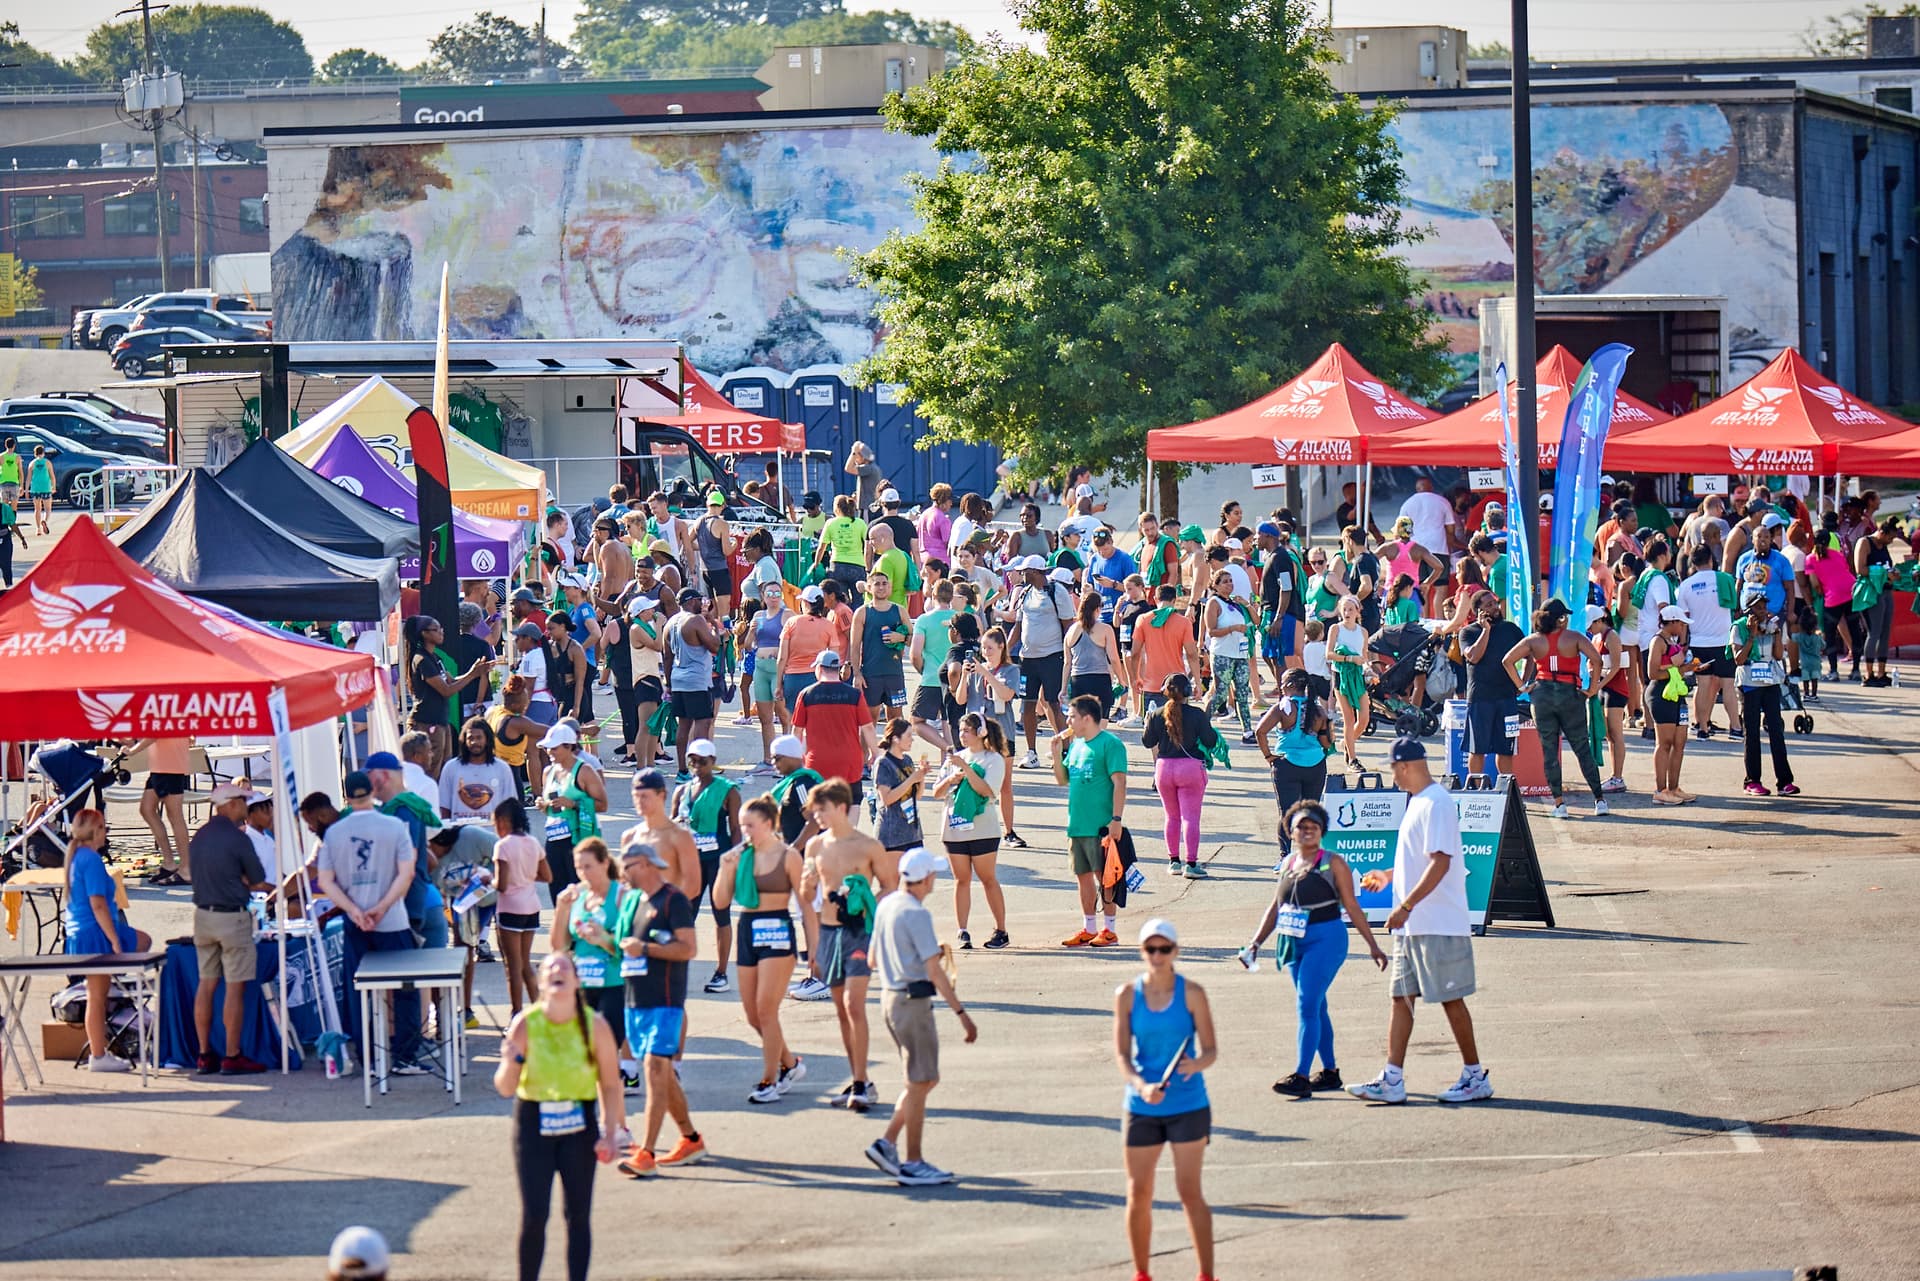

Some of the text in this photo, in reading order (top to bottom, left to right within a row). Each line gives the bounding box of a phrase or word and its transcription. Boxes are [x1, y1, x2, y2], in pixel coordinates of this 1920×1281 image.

[414, 105, 484, 124] Good
[1263, 404, 1324, 415] ATLANTA
[1578, 371, 1599, 455] FREE
[1714, 411, 1780, 423] ATLANTA
[1832, 411, 1881, 422] ATLANTA
[1299, 439, 1352, 454] ATLANTA
[1757, 449, 1814, 464] ATLANTA
[1757, 463, 1814, 471] TRACK CLUB
[1261, 473, 1276, 483] 3XL
[1478, 477, 1495, 486] 2XL
[1705, 482, 1716, 491] XL
[73, 644, 126, 654] CLUB
[139, 690, 258, 719] ATLANTA
[139, 718, 259, 732] TRACK CLUB
[1363, 802, 1391, 810] Atlanta
[1467, 803, 1491, 811] Atlanta
[1360, 810, 1392, 818] BeltLine
[1465, 811, 1492, 819] BeltLine
[1336, 839, 1387, 849] NUMBER
